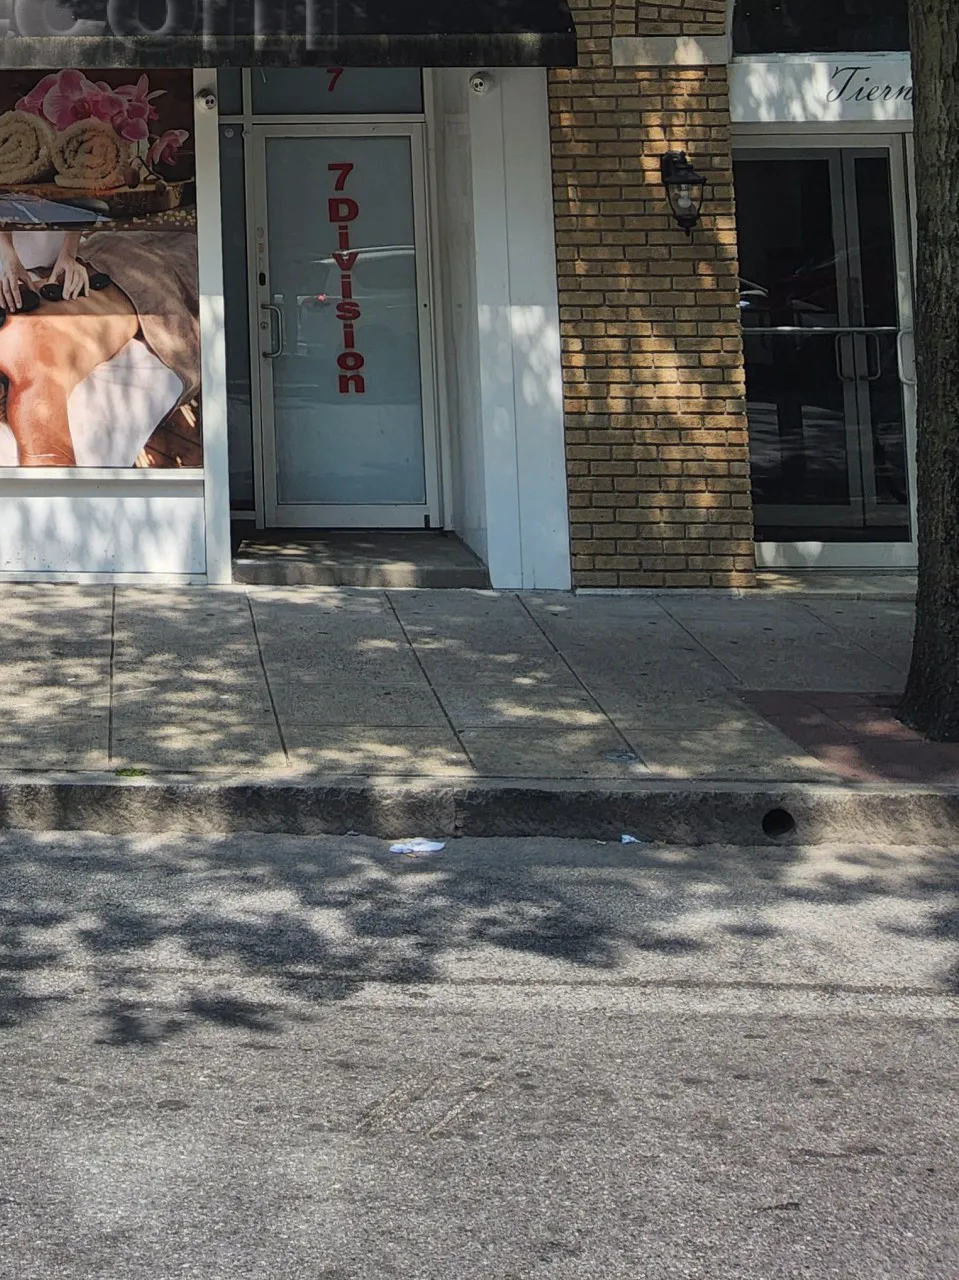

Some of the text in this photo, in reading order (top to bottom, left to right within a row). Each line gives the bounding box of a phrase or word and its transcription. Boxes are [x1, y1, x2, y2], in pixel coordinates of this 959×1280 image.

[326, 67, 344, 92] 7
[327, 162, 366, 394] 7 Division
